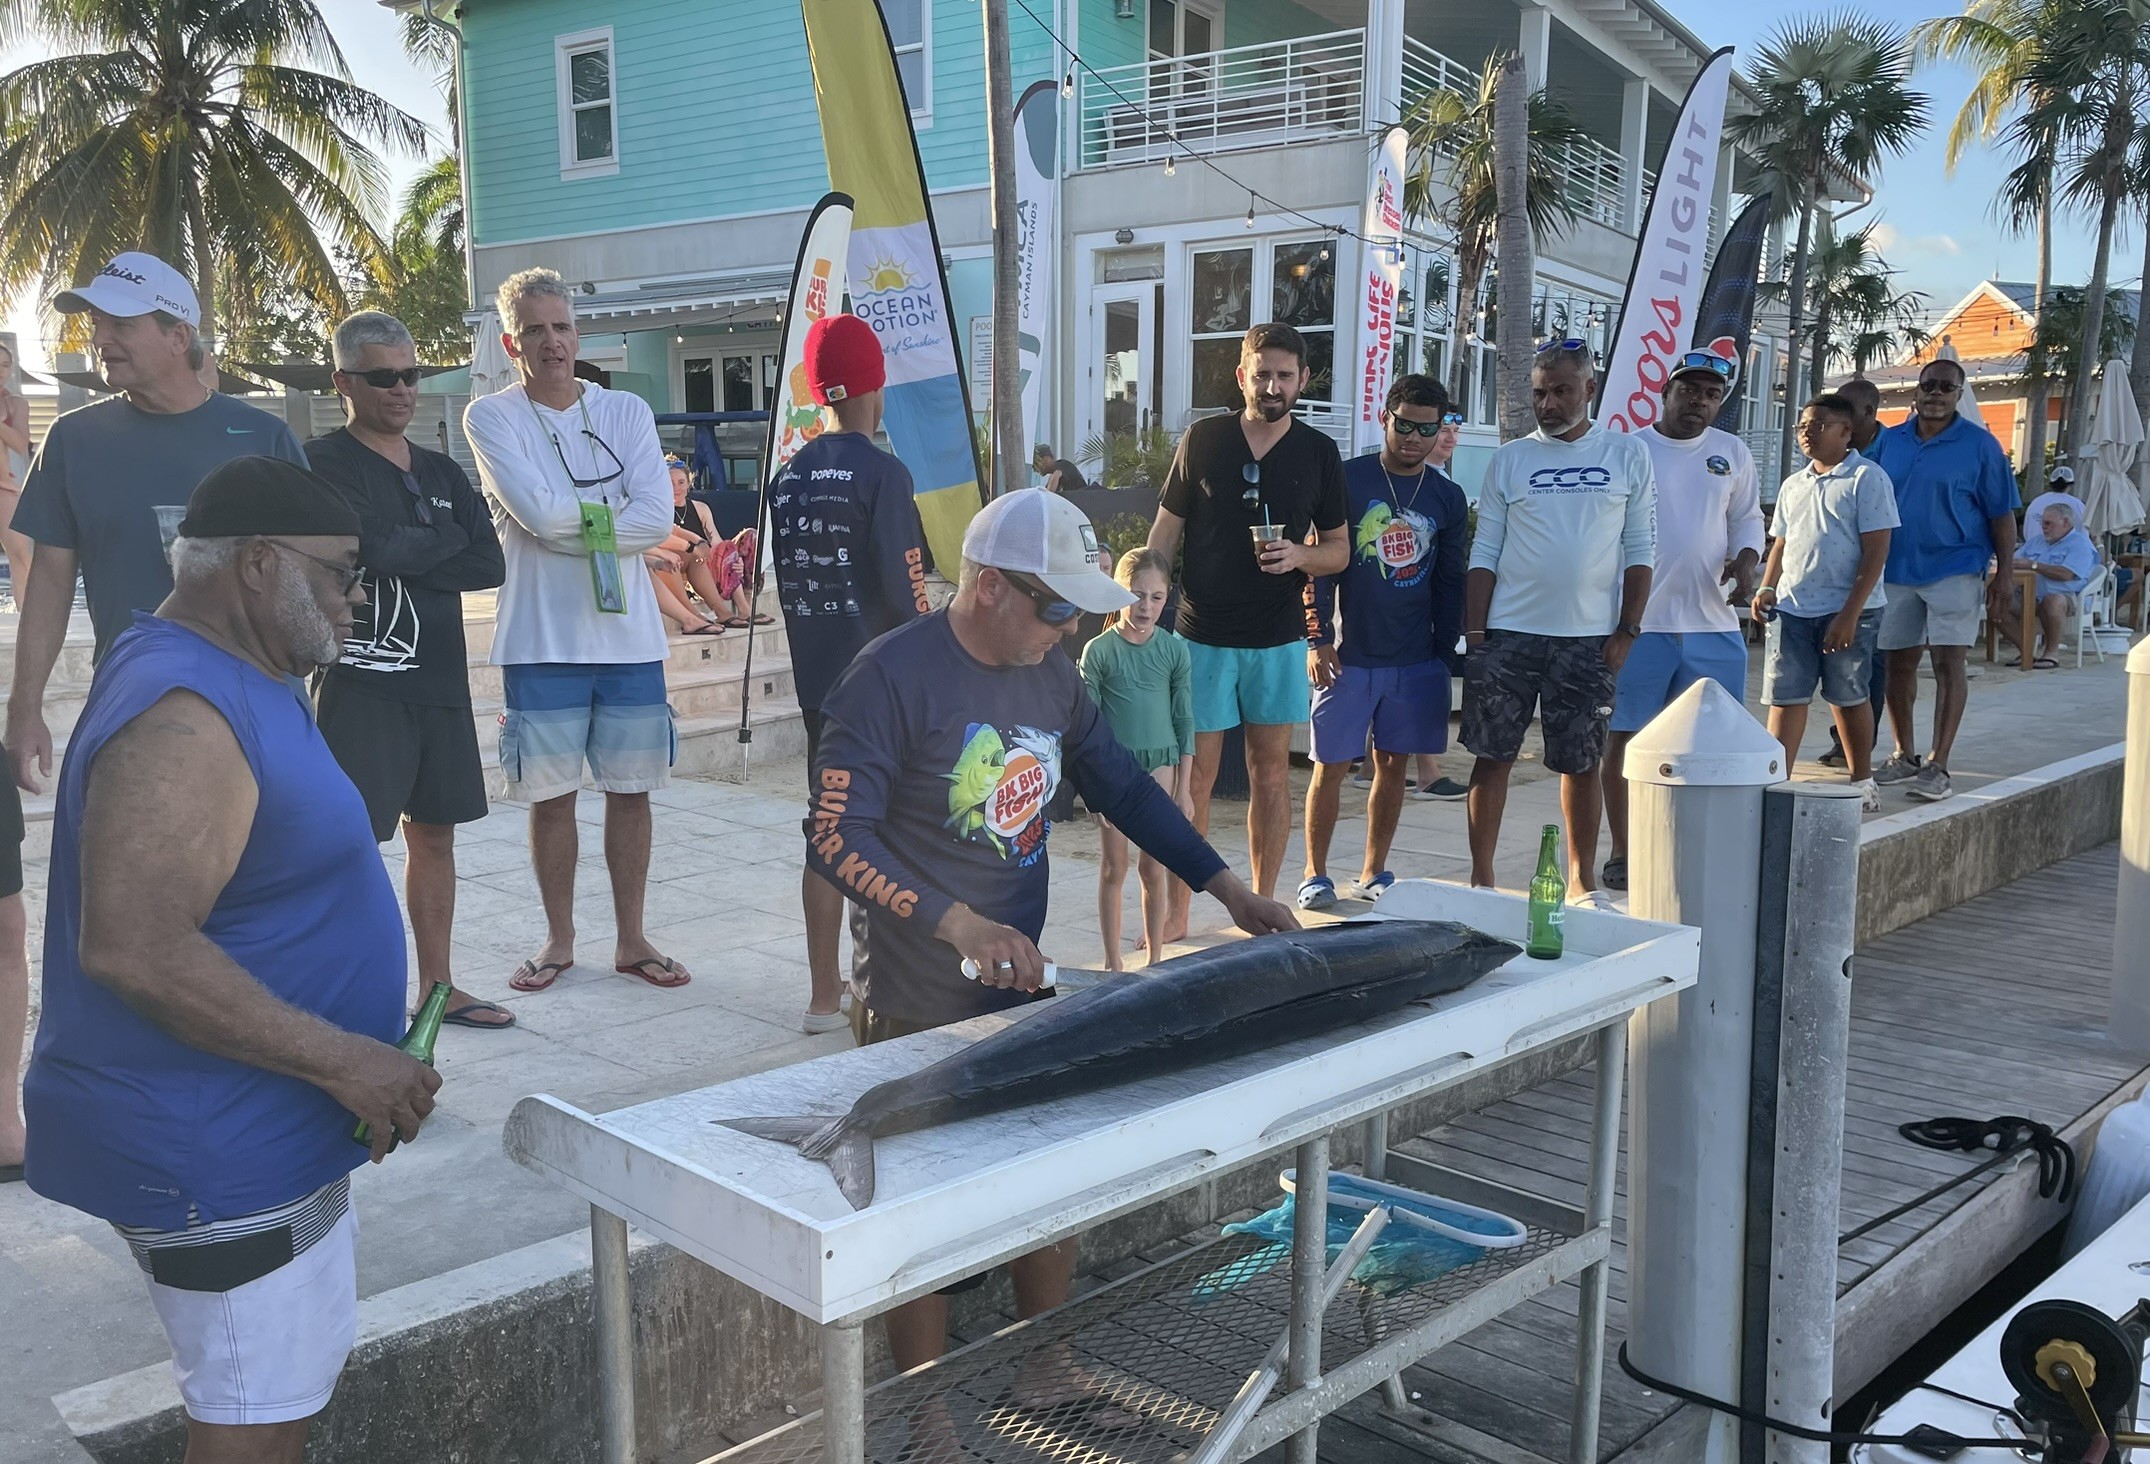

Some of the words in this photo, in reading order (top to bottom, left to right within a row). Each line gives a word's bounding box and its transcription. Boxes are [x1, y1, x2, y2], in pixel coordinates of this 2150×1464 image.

[1659, 110, 1708, 287] LIGHT
[1027, 202, 1038, 259] ISLANDS
[100, 263, 147, 286] leist
[1022, 261, 1033, 319] CAYMAN
[155, 294, 179, 311] PRO
[856, 293, 932, 319] OCEAN
[872, 309, 936, 333] OTION
[975, 322, 993, 331] POO
[892, 340, 901, 356] of
[903, 334, 941, 351] Sunshine
[828, 495, 849, 503] MEDIA
[1555, 487, 1593, 495] CONSOLES
[1381, 534, 1395, 545] BK
[1395, 531, 1413, 542] BIG
[1383, 542, 1415, 558] FISH
[904, 546, 930, 614] BURG
[824, 601, 838, 611] C3
[996, 780, 1019, 805] BK
[1018, 766, 1043, 793] BIG
[994, 782, 1044, 825] FISH
[836, 852, 919, 918] KING
